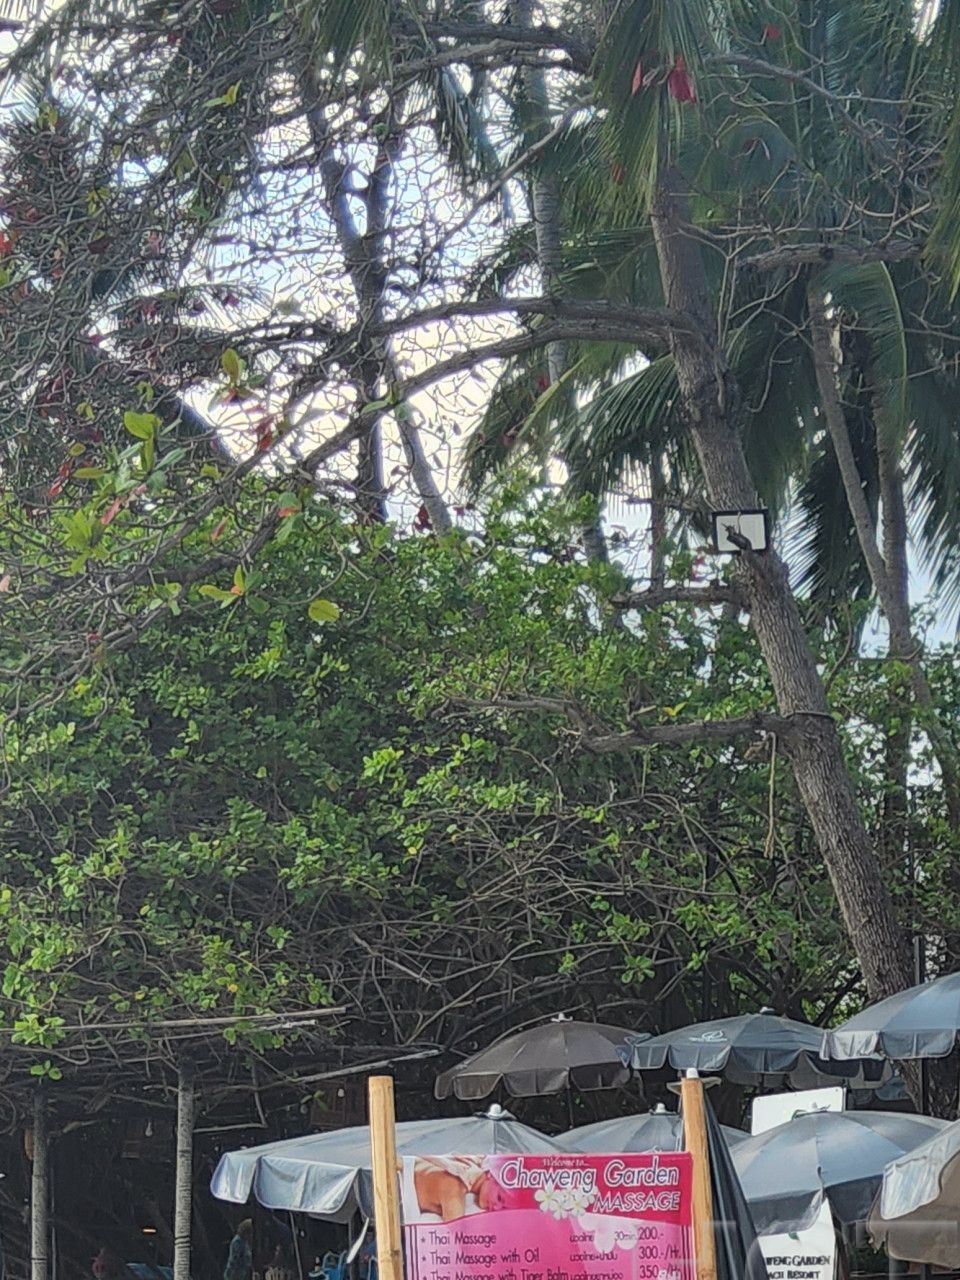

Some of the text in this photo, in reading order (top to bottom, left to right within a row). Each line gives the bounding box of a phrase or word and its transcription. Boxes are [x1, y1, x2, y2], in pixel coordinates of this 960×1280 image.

[500, 1156, 679, 1194] Chaweng Garden
[592, 1191, 681, 1213] MASSAGE
[429, 1230, 496, 1247] Thai Massage
[430, 1248, 539, 1268] Thai Massage with Oil
[793, 1255, 830, 1266] GARDEN
[787, 1270, 820, 1279] RESORT
